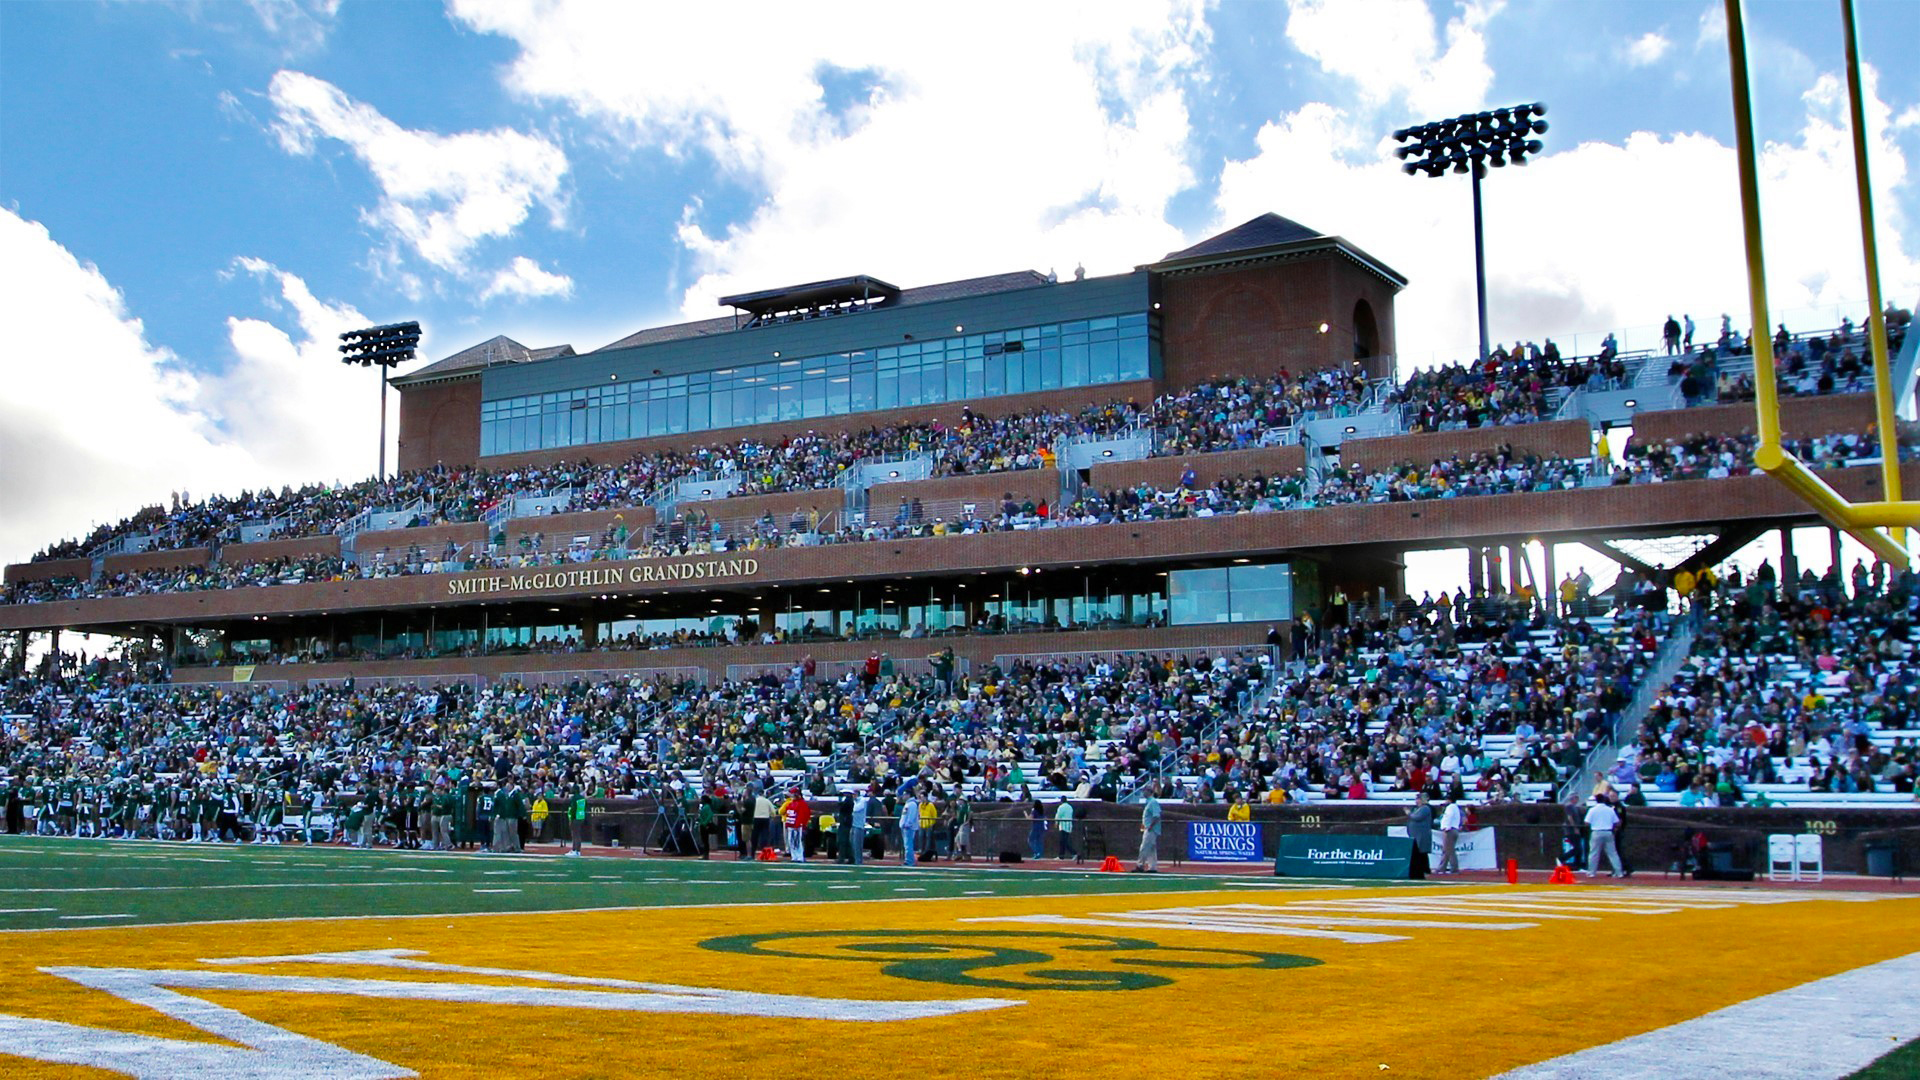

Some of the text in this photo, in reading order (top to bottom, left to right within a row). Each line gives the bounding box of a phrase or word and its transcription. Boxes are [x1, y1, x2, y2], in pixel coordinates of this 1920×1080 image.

[629, 559, 758, 583] GRANDSTAND
[1300, 815, 1320, 828] 101
[1805, 821, 1836, 835] 100
[1193, 823, 1256, 837] DIAMOND
[1194, 836, 1255, 851] SPRINGS
[1307, 848, 1383, 860] For the Bold
